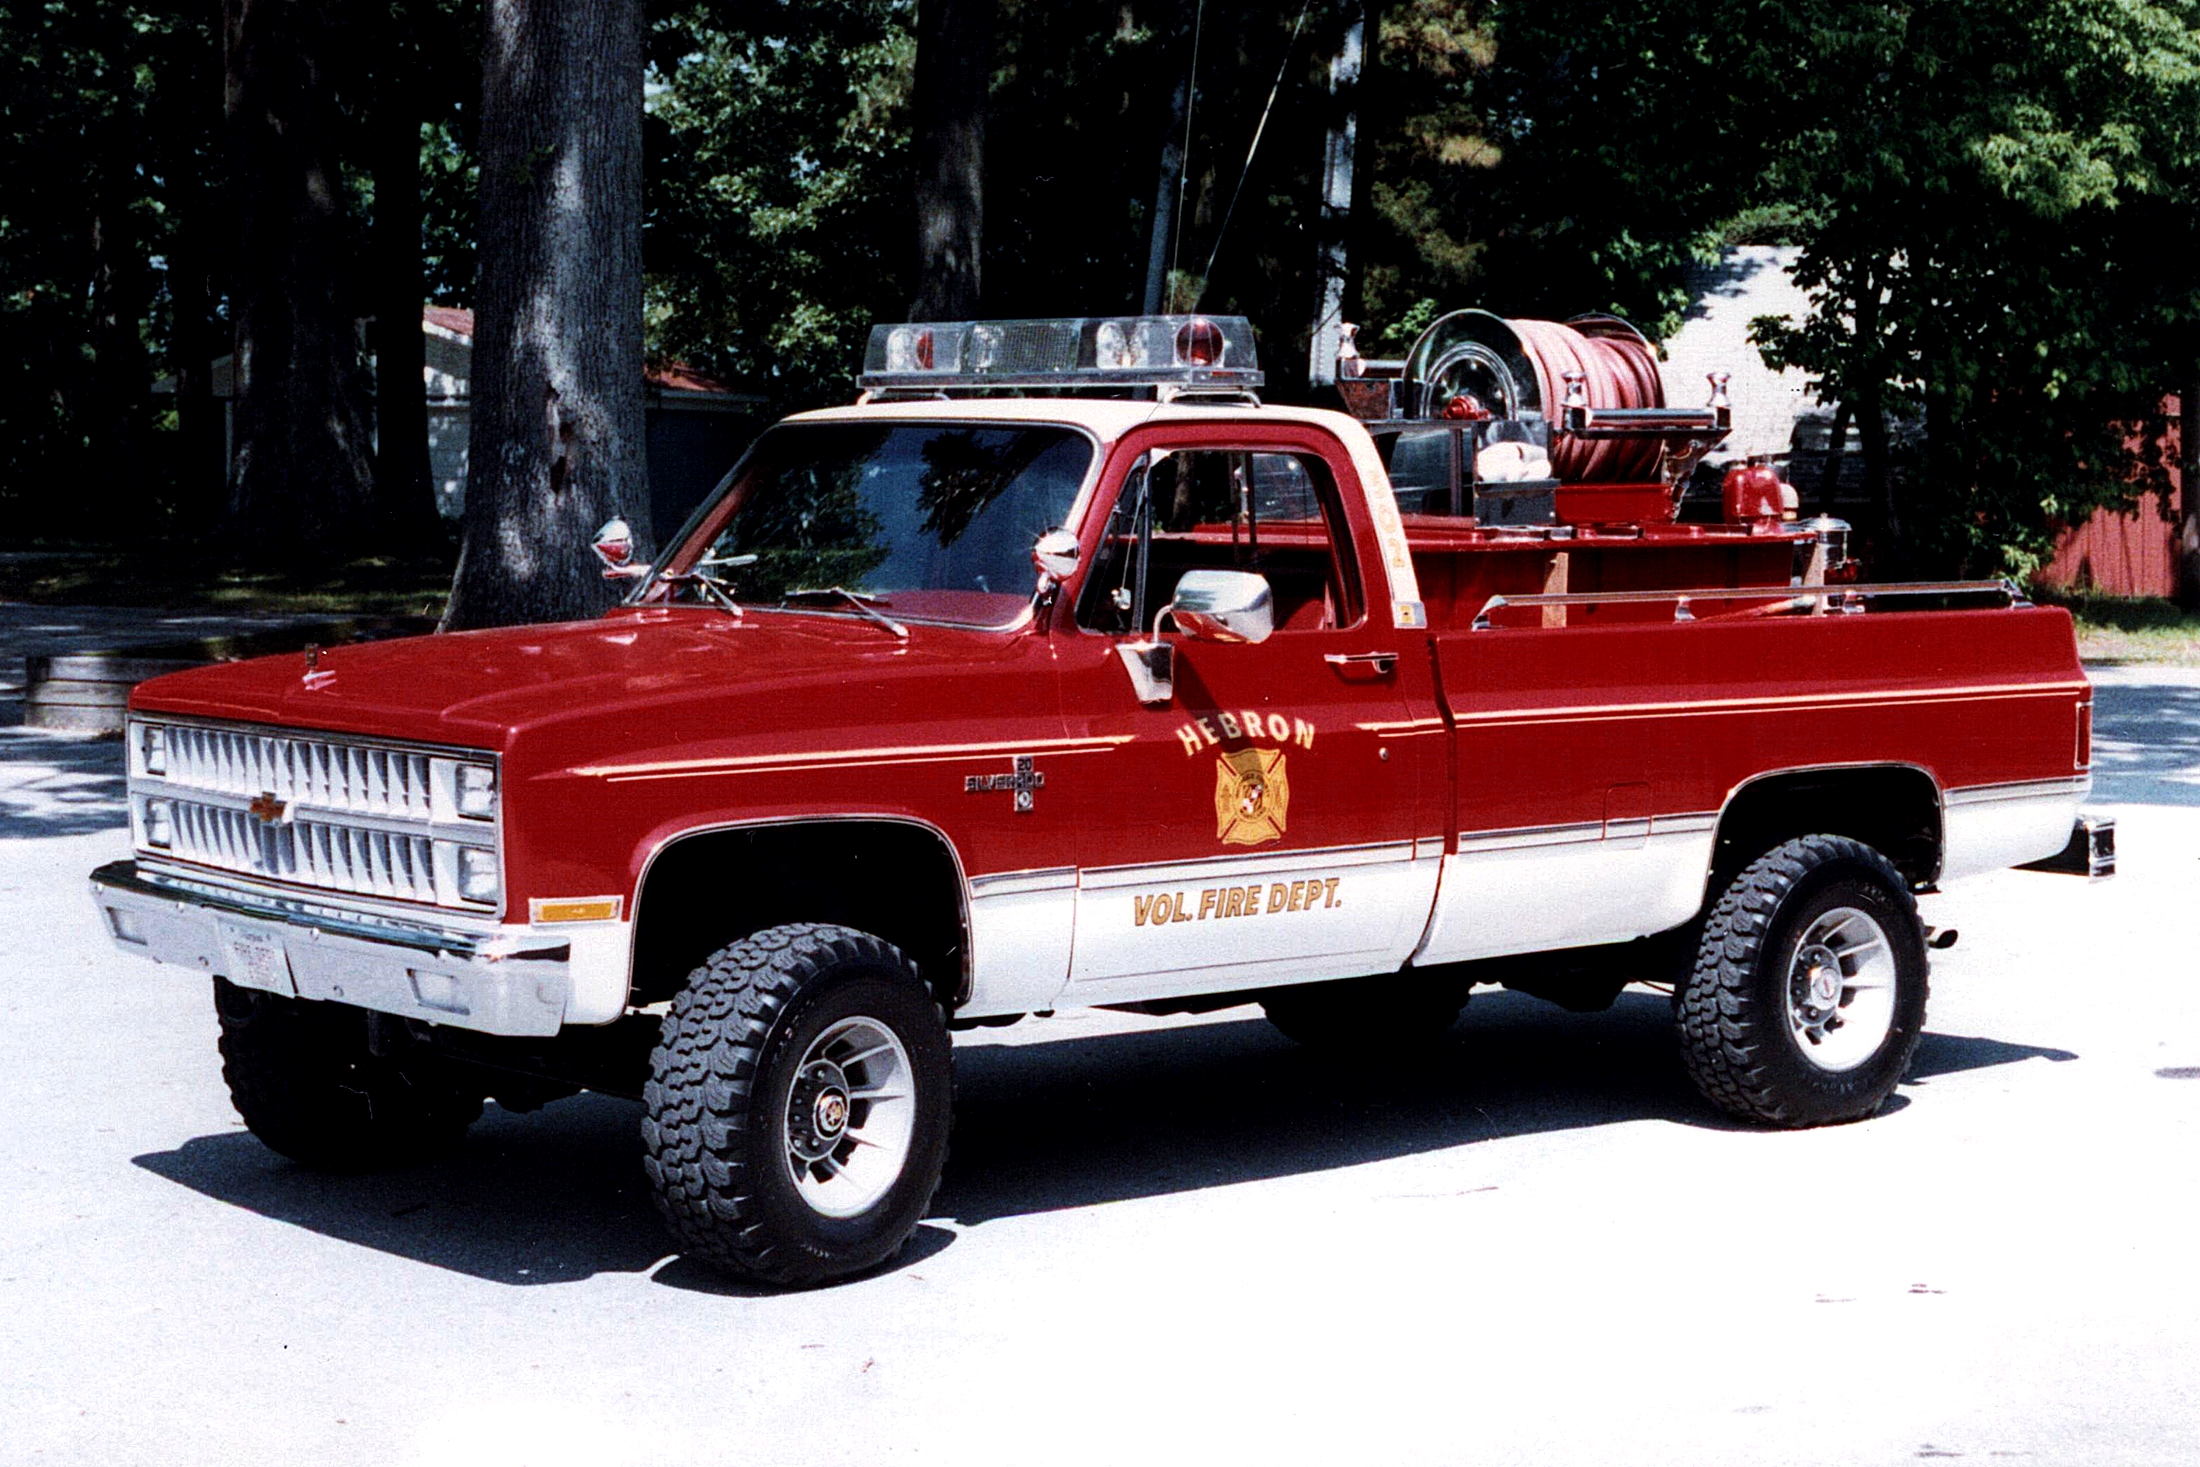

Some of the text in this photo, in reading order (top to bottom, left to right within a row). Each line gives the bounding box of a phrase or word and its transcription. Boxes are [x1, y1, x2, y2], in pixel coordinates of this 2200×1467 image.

[1176, 711, 1315, 756] HEBRON
[1134, 878, 1342, 926] VOL. FIRE DEPT.
